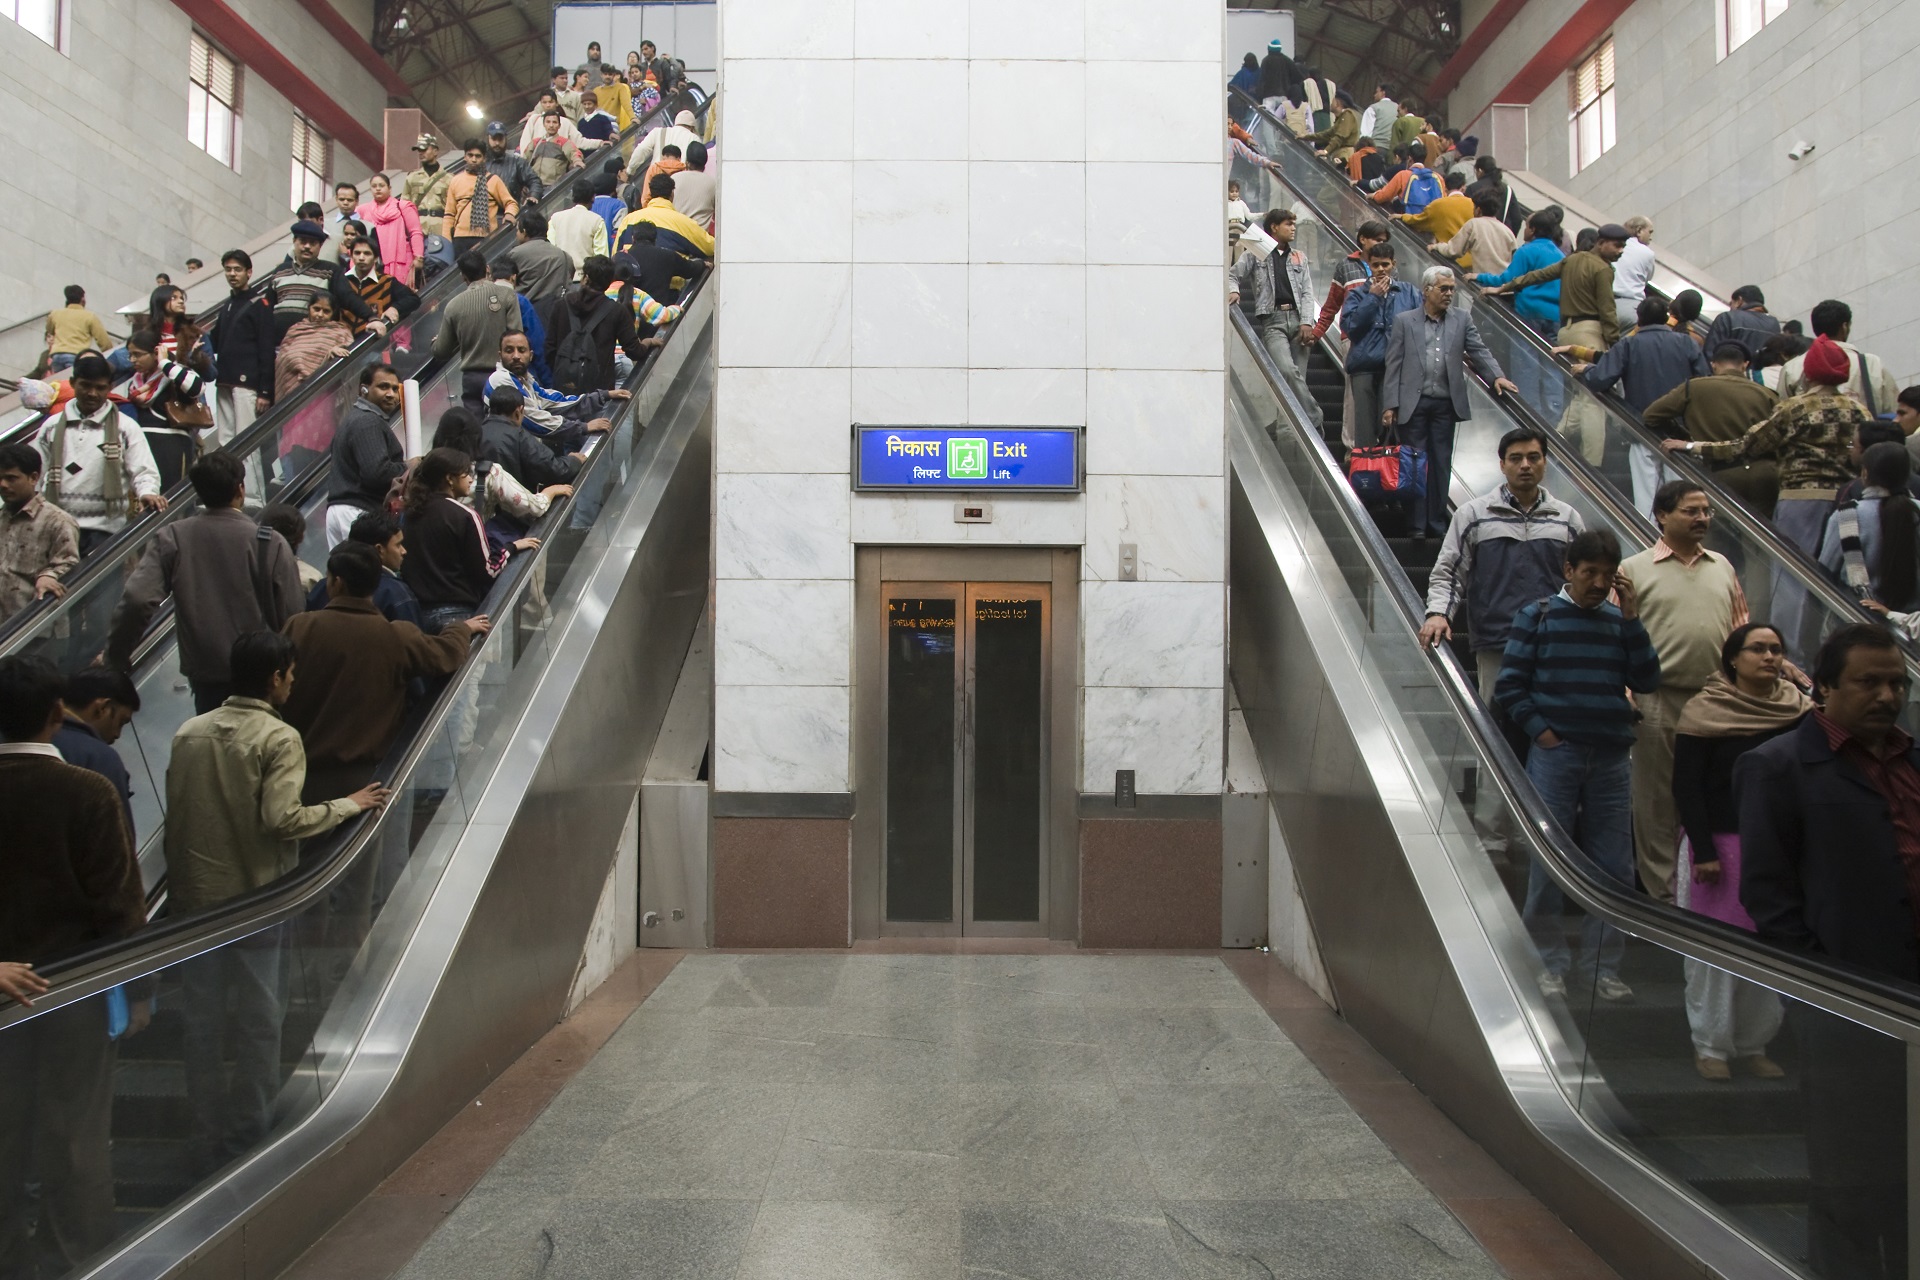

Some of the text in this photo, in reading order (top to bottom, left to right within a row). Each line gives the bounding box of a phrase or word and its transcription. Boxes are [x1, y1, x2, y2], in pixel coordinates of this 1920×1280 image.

[886, 435, 941, 457] निकास
[993, 441, 1027, 458] Exit
[913, 466, 941, 479] लिफ्ट
[993, 469, 1010, 479] Lift
